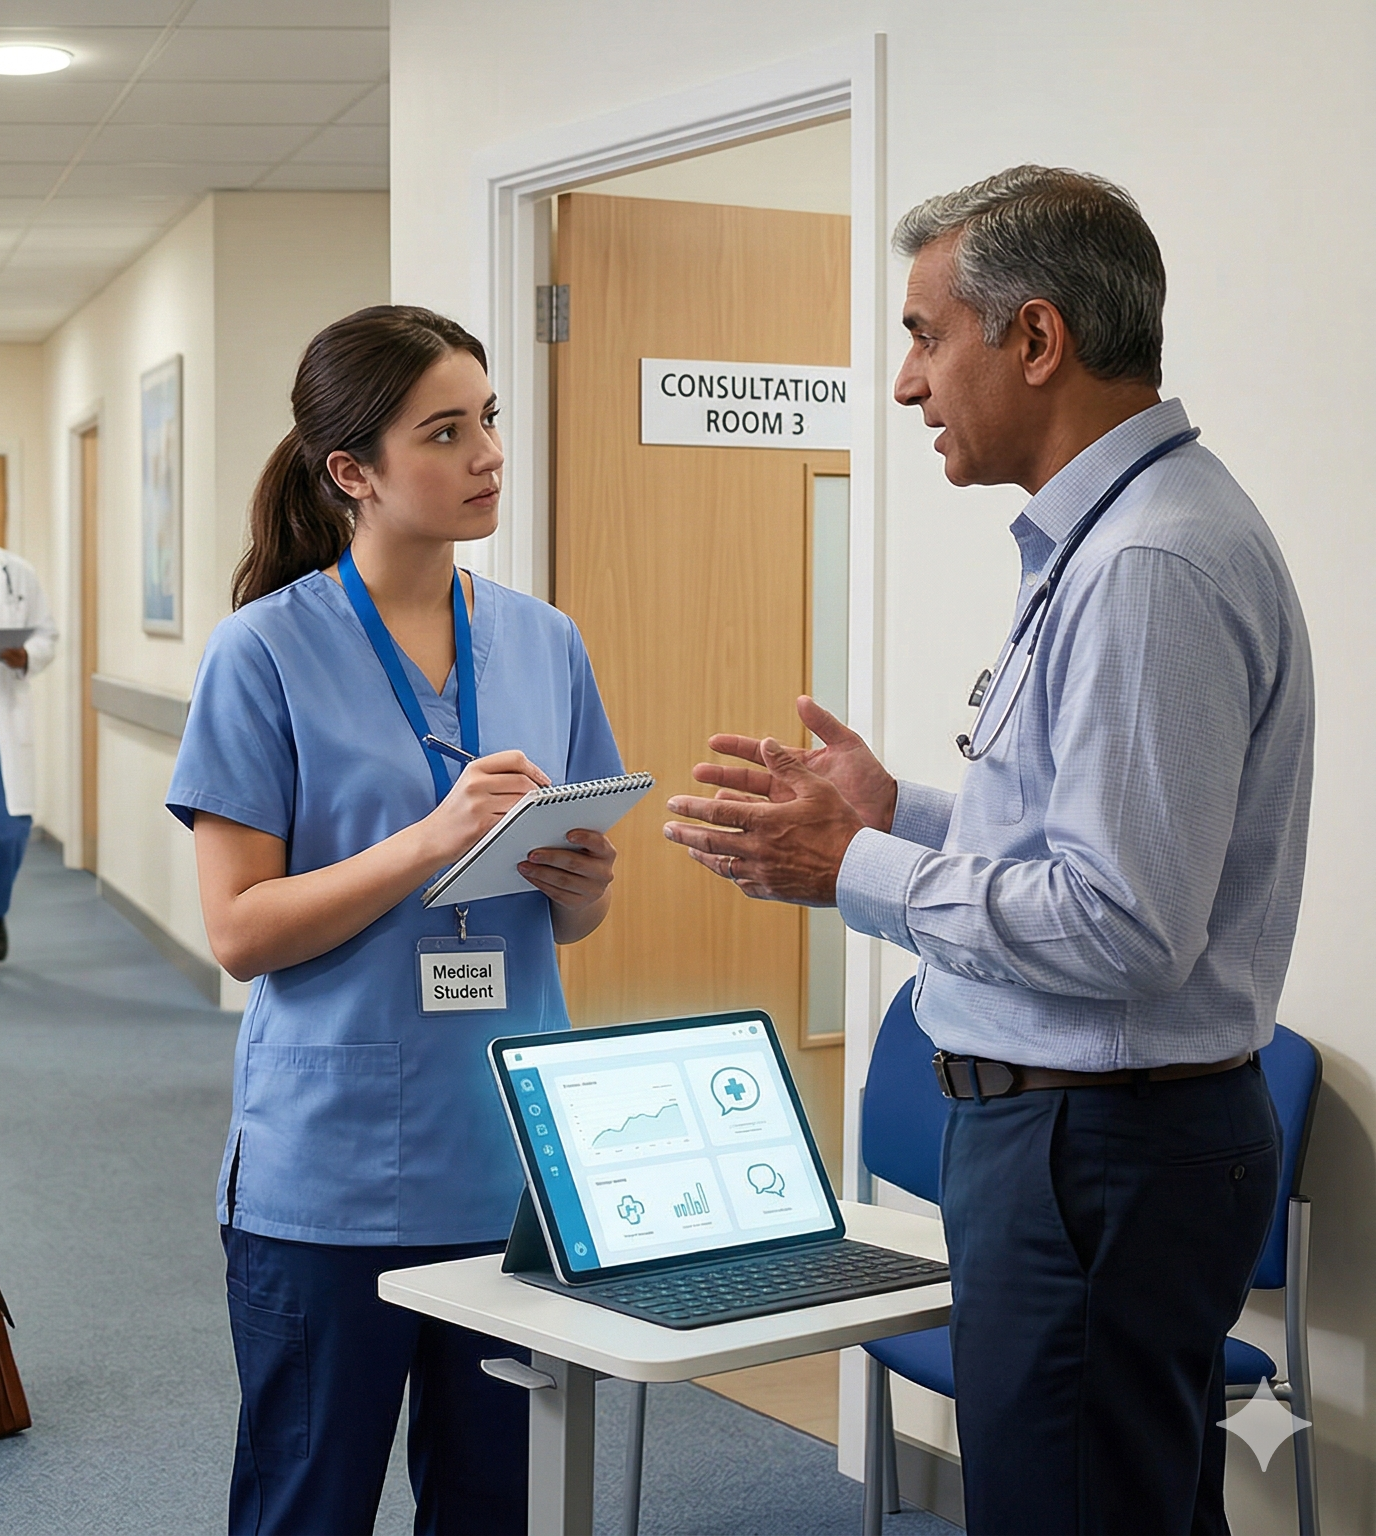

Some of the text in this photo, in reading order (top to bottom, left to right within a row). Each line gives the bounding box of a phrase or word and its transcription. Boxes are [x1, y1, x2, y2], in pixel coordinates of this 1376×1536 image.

[660, 373, 847, 403] CONSULTATION
[706, 409, 805, 436] ROOM 3
[432, 963, 492, 980] Medical
[433, 984, 494, 1000] Student
